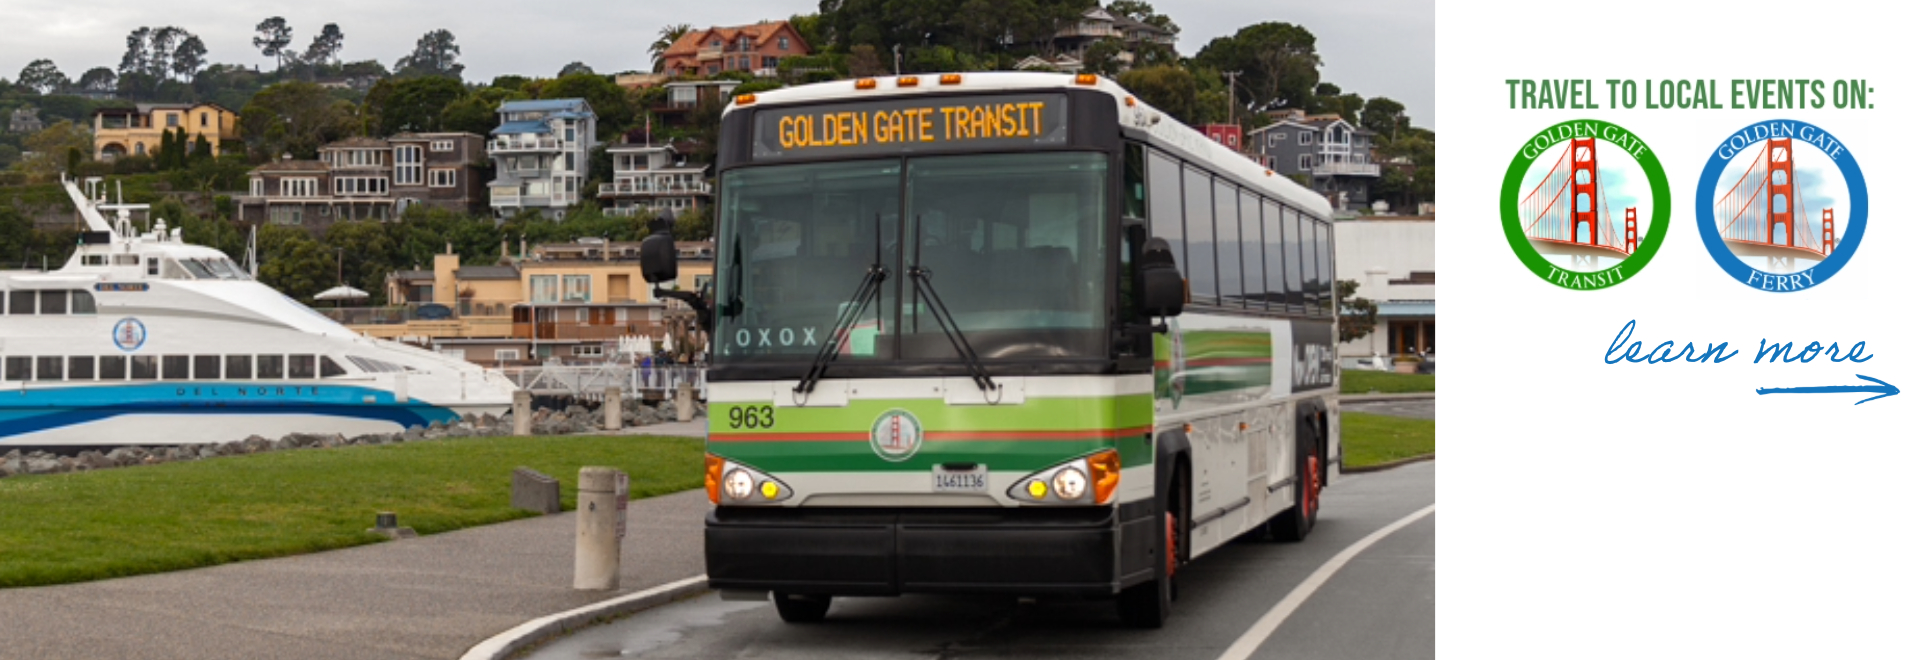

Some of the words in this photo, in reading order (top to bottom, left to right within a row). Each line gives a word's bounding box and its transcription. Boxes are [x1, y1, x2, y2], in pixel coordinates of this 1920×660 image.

[778, 111, 868, 149] GOLDEN
[873, 107, 934, 143] GATE
[940, 101, 1045, 141] TRANSIT
[176, 387, 219, 396] DEL
[238, 386, 319, 396] NORTE
[729, 405, 774, 429] 963
[937, 473, 984, 488] 1461136
